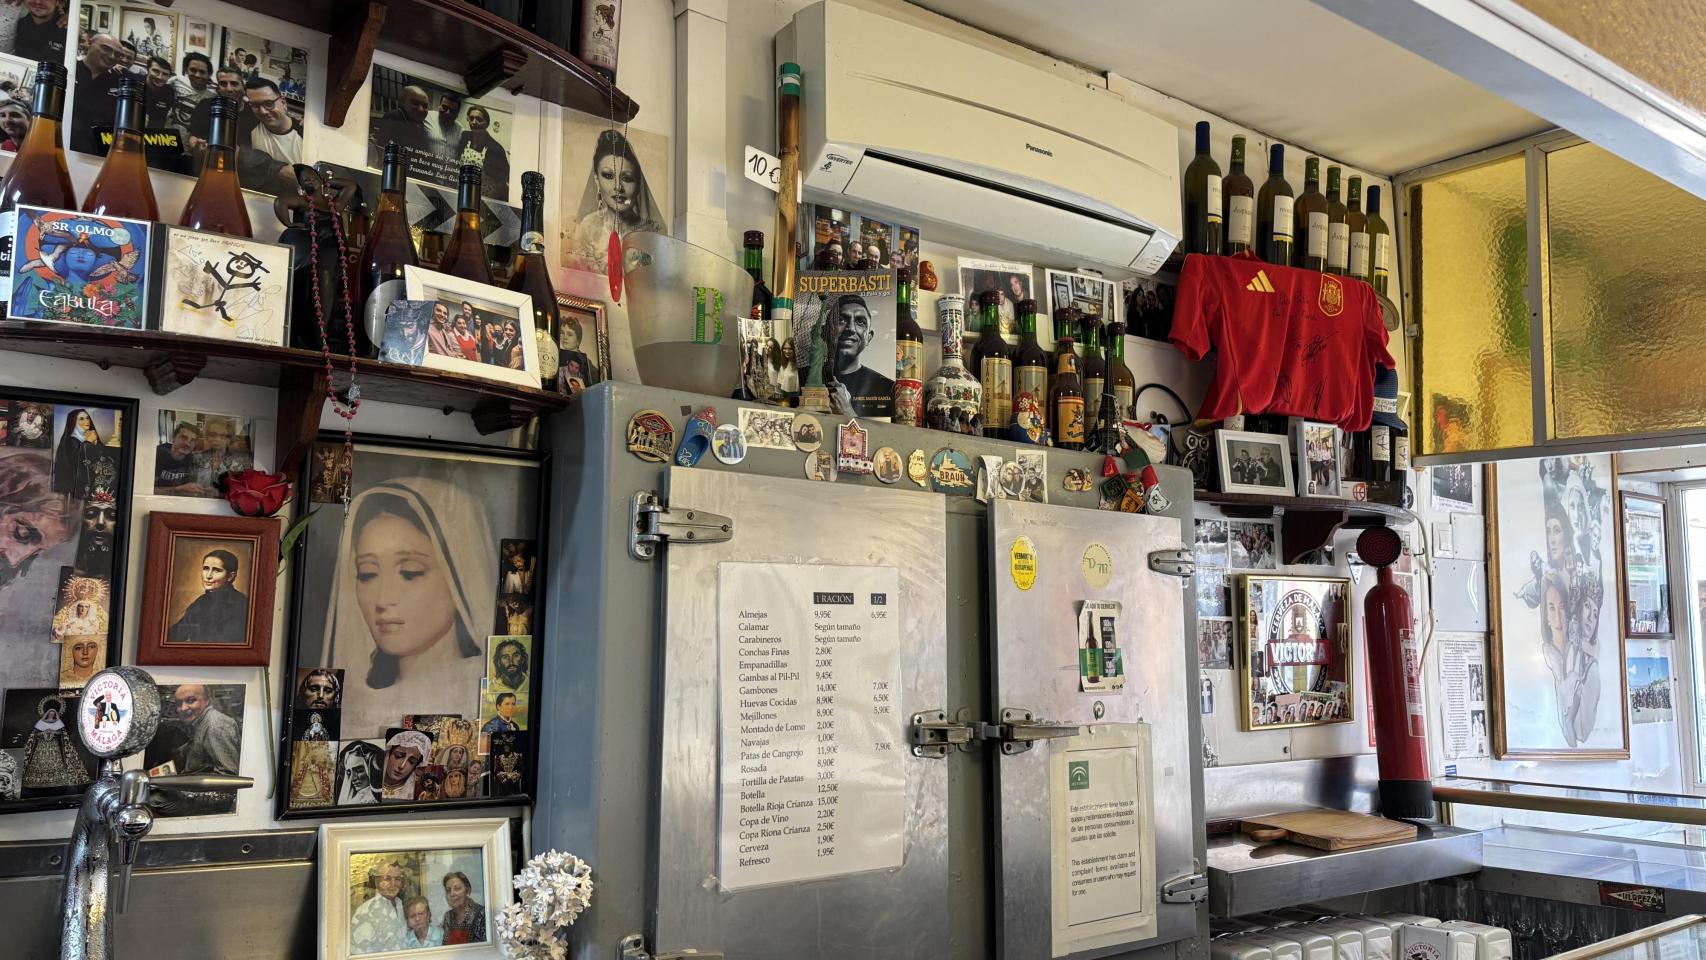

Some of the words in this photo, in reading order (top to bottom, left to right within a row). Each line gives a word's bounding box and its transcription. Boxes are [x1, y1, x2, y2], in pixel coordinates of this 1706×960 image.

[1025, 143, 1053, 157] Panasonic
[419, 158, 431, 166] beso
[749, 154, 767, 176] 10
[826, 152, 853, 168] INVERTER
[409, 164, 434, 176] Fernando
[76, 224, 114, 237] OLMO
[800, 275, 891, 293] SUPERBASTI
[940, 471, 965, 482] BRAUN
[874, 595, 883, 604] 1/2
[738, 611, 767, 619] Almejas
[815, 611, 831, 619] 9,95€
[871, 611, 887, 619] 6,95€
[1272, 596, 1294, 634] CERVEZA
[1294, 594, 1303, 604] DE
[815, 623, 835, 631] Según
[738, 636, 781, 644] Carabineros
[815, 635, 835, 643] Según
[837, 635, 861, 643] tamaño
[771, 648, 790, 656] Finas
[815, 647, 832, 656] 2,80€
[1270, 643, 1326, 664] VICTORIA
[739, 661, 787, 670] Empanadillas
[816, 660, 832, 668] 2,00€
[739, 673, 768, 682] Gambas
[770, 673, 777, 681] al
[778, 672, 799, 681] Pil-Pil
[816, 672, 832, 680] 9,45€
[90, 681, 126, 701] VICTORIA
[739, 686, 778, 695] Gambones
[817, 684, 837, 692] 14,00€
[873, 682, 888, 690] 7,00€
[740, 700, 768, 708] Huevas
[769, 698, 797, 706] Cocidas
[816, 696, 833, 704] 8,90€
[873, 694, 889, 702] 6,50€
[740, 712, 777, 721] Mejillones
[817, 709, 834, 717] 8,90€
[740, 725, 773, 734] Montado
[775, 724, 784, 732] de
[785, 723, 805, 731] Lomo
[817, 721, 834, 729] 2,00€
[91, 730, 123, 745] MÁLAGA
[740, 738, 769, 747] Navajas
[740, 752, 761, 760] Patas
[762, 751, 771, 759] de
[772, 749, 803, 758] Cangrejo
[875, 743, 891, 751] 7,90€
[741, 765, 767, 773] Rosada
[817, 759, 834, 767] 8,90€
[741, 778, 767, 787] Tortilla
[779, 774, 804, 784] Patatas
[741, 791, 765, 800] Botella
[818, 784, 838, 793] 12,50€
[741, 804, 765, 813] Botella
[767, 802, 785, 812] Rioja
[786, 799, 813, 808] Crianza
[818, 796, 838, 806] 15,00€
[740, 818, 760, 828] Copa
[772, 815, 789, 823] Vino
[817, 809, 834, 818] 2,20€
[740, 831, 759, 841] Copa
[783, 826, 811, 834] Crianza
[817, 822, 834, 831] 2,50€
[1085, 823, 1102, 832] personas
[740, 844, 769, 853] Cerveza
[817, 835, 834, 844] 1,90€
[740, 856, 770, 867] Refresco
[817, 848, 834, 857] 1,95€
[1081, 856, 1108, 864] establishment
[1072, 868, 1093, 876] complaint
[1408, 944, 1440, 959] VICTORIA
